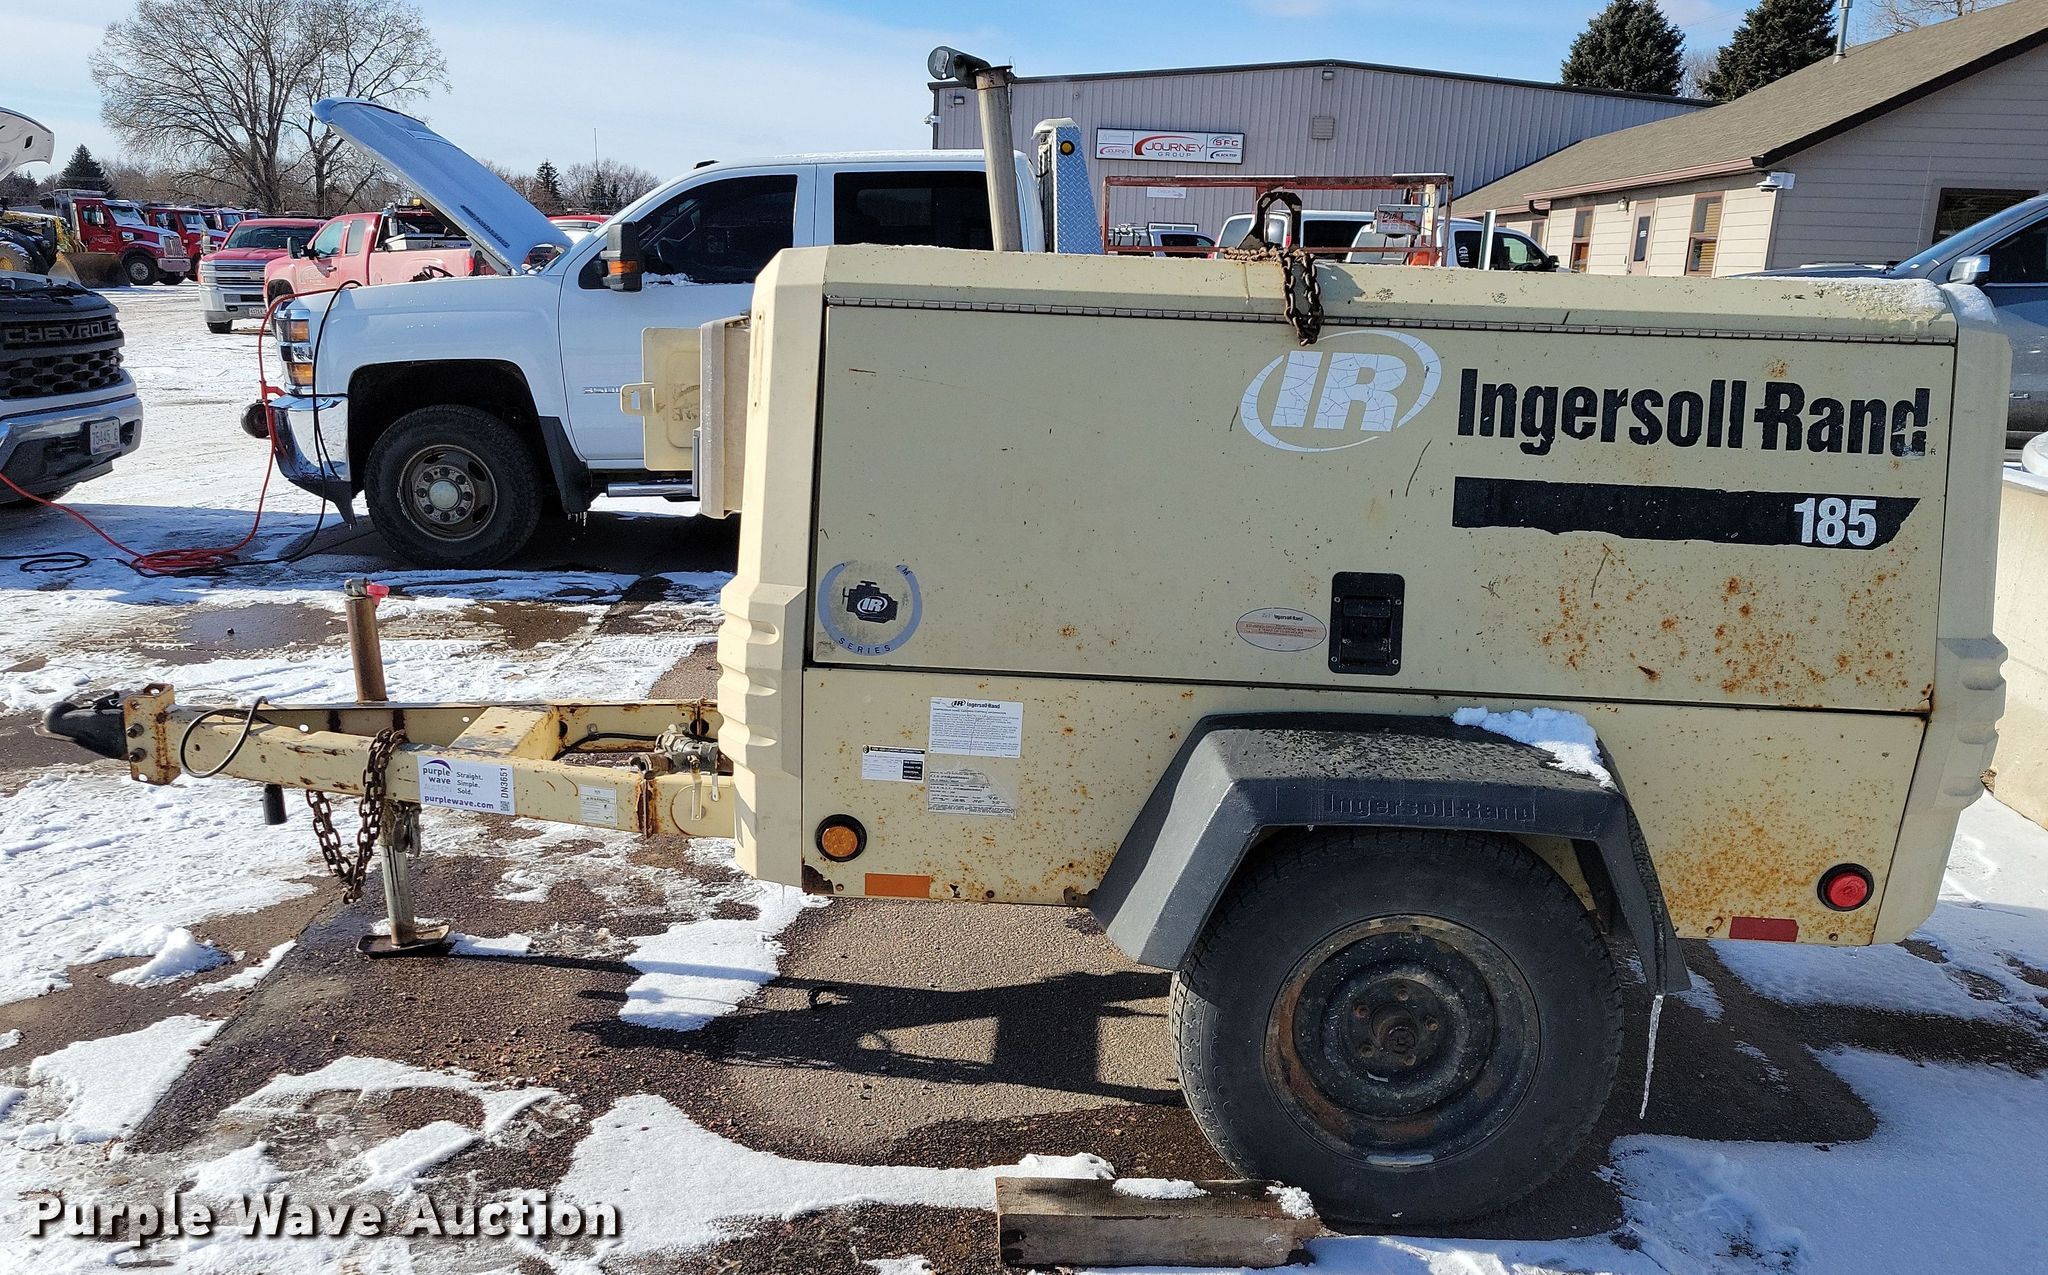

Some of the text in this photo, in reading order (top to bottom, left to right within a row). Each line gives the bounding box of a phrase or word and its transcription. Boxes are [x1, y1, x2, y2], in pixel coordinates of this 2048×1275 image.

[1145, 142, 1205, 152] JOURNEY
[1215, 139, 1239, 147] SFC
[5, 320, 120, 343] CHEVROLE
[1271, 350, 1408, 433] IR
[1794, 497, 1877, 547] 185
[860, 597, 884, 613] IR
[838, 637, 891, 654] SERIES
[422, 768, 451, 777] purple
[456, 771, 484, 781] Straight.
[429, 777, 451, 785] wave
[456, 781, 481, 789] Simple.
[500, 767, 509, 799] DN3651
[457, 787, 473, 795] Sold.
[424, 795, 494, 810] purplewave.com
